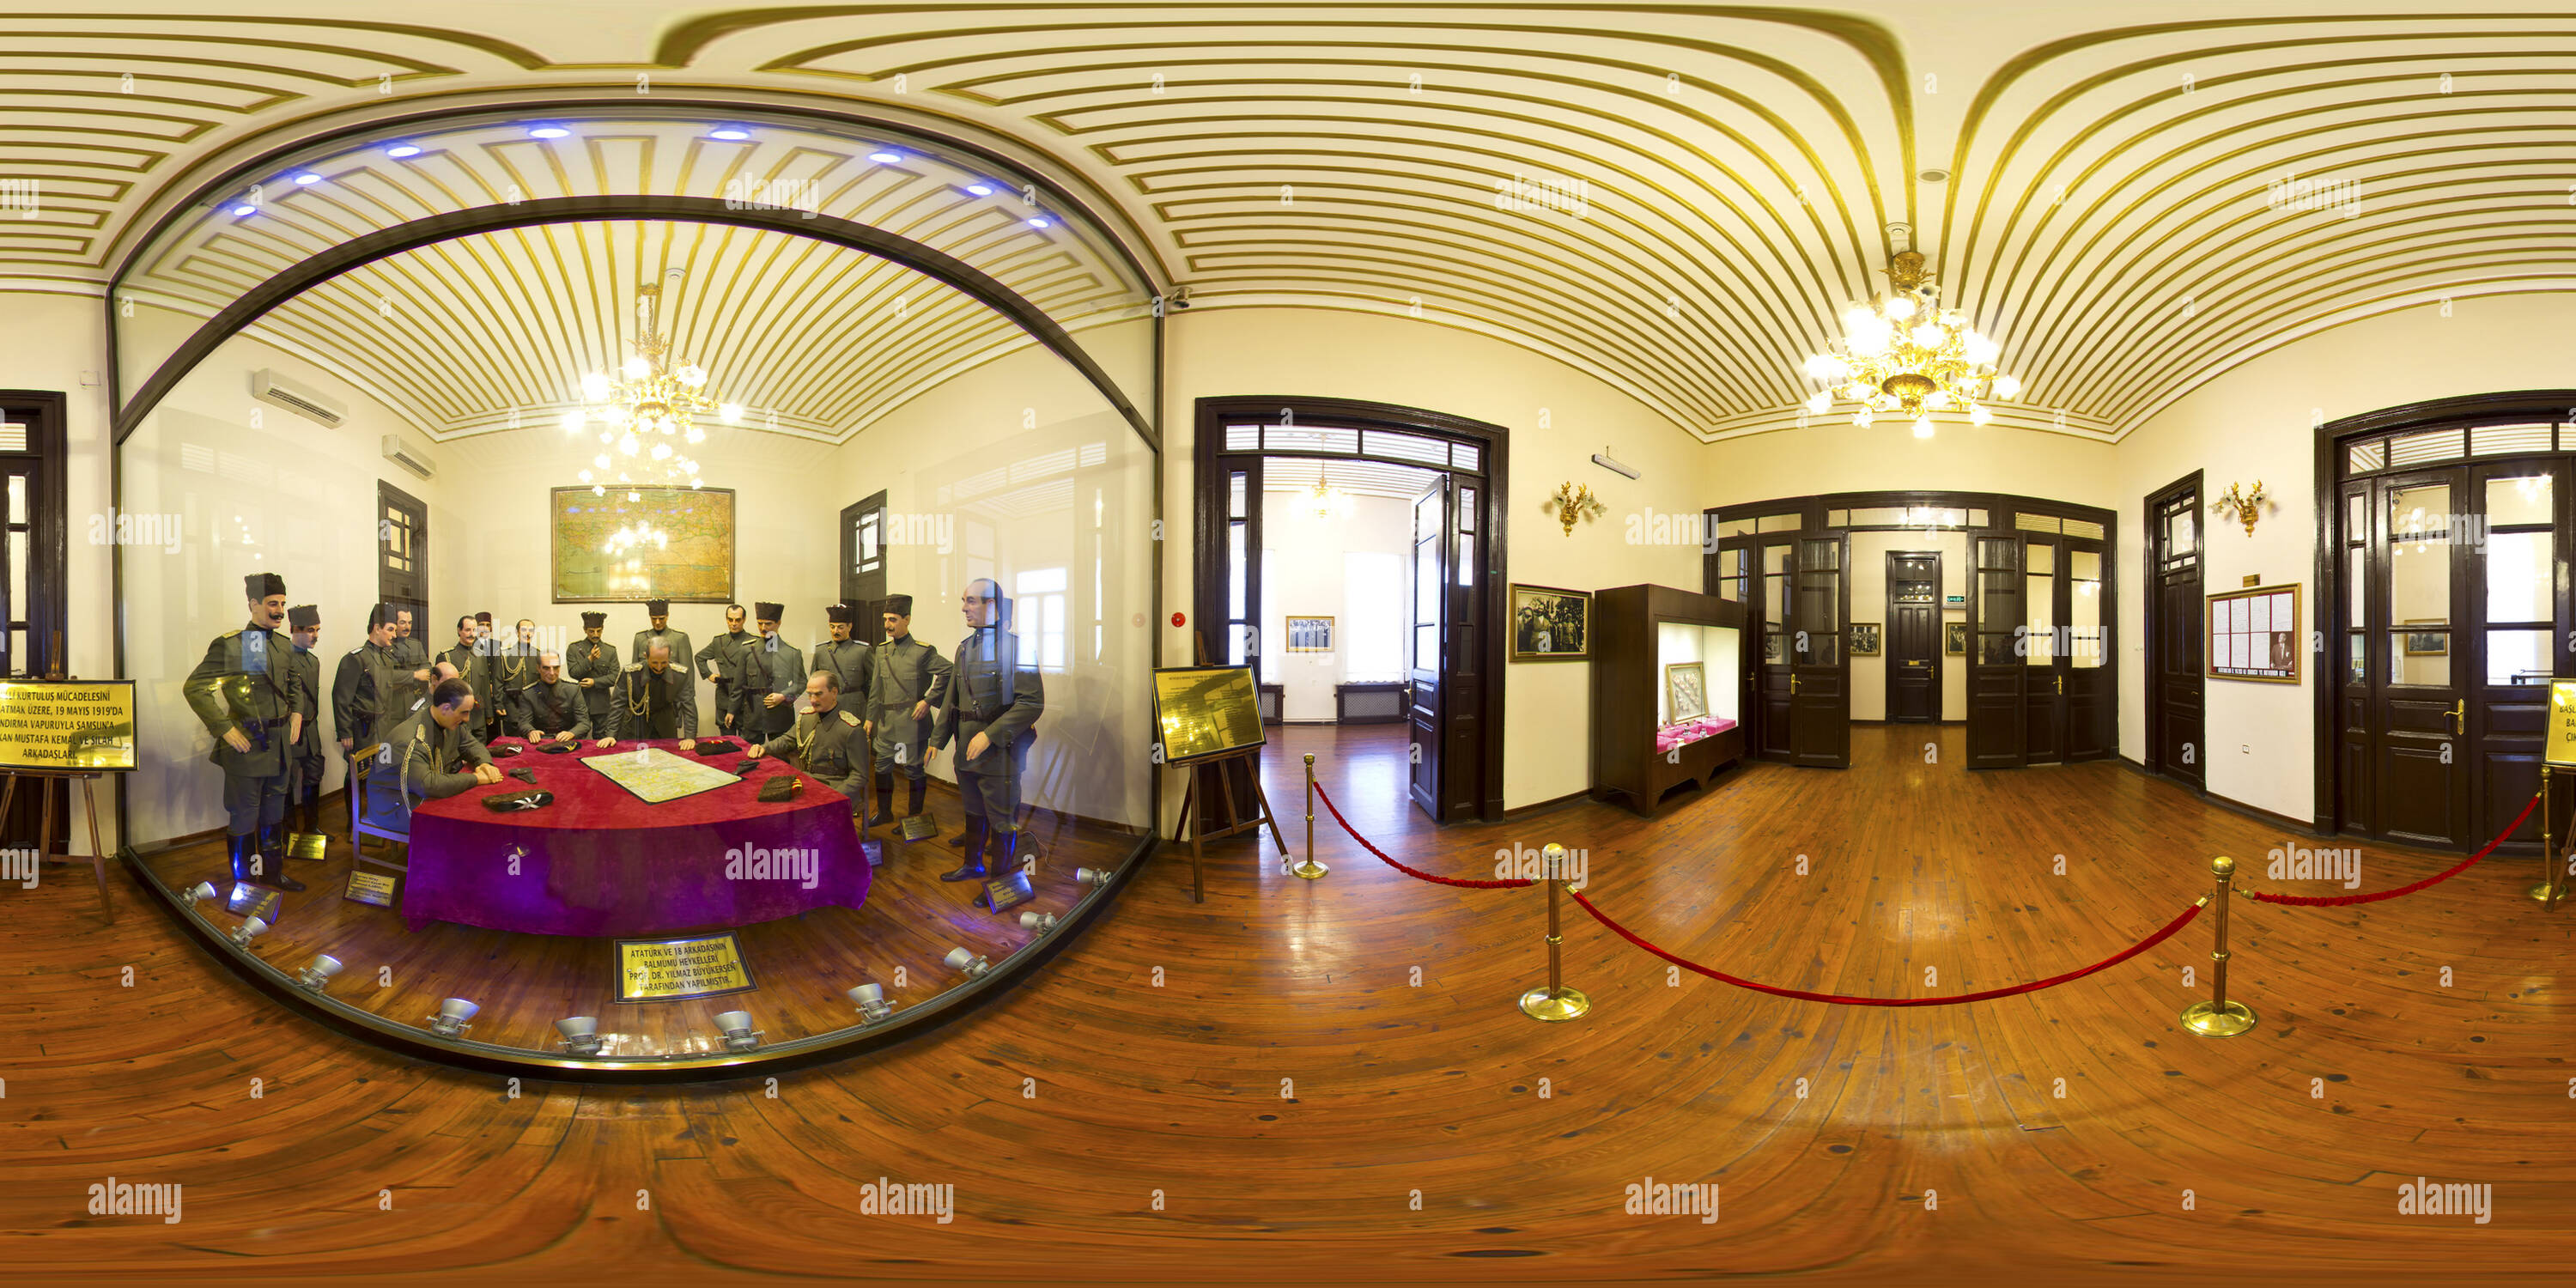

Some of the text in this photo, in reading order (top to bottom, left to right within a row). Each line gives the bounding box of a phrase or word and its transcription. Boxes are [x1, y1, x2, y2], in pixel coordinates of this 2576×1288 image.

[17, 692, 54, 703] KURTULUŞ
[57, 690, 110, 701] MÜCADELESİNİ
[56, 707, 64, 715] 19
[67, 707, 89, 715] MAYIS
[93, 706, 123, 715] 1919'DA
[30, 720, 75, 730] VAPURUYLA
[76, 720, 114, 730] SAMSUN'A
[15, 733, 49, 744] MUSTAFA
[52, 735, 76, 744] KEMAL
[79, 735, 88, 744] VE
[22, 748, 77, 761] ARKADAŞLARI.
[631, 947, 662, 958] ATATÜRK
[684, 942, 726, 954] ARKADAŞININ
[644, 958, 677, 969] BALMUMU
[652, 971, 665, 980] DR.
[665, 969, 691, 978] YILMAZ
[639, 981, 685, 991] TARAFINDAN
